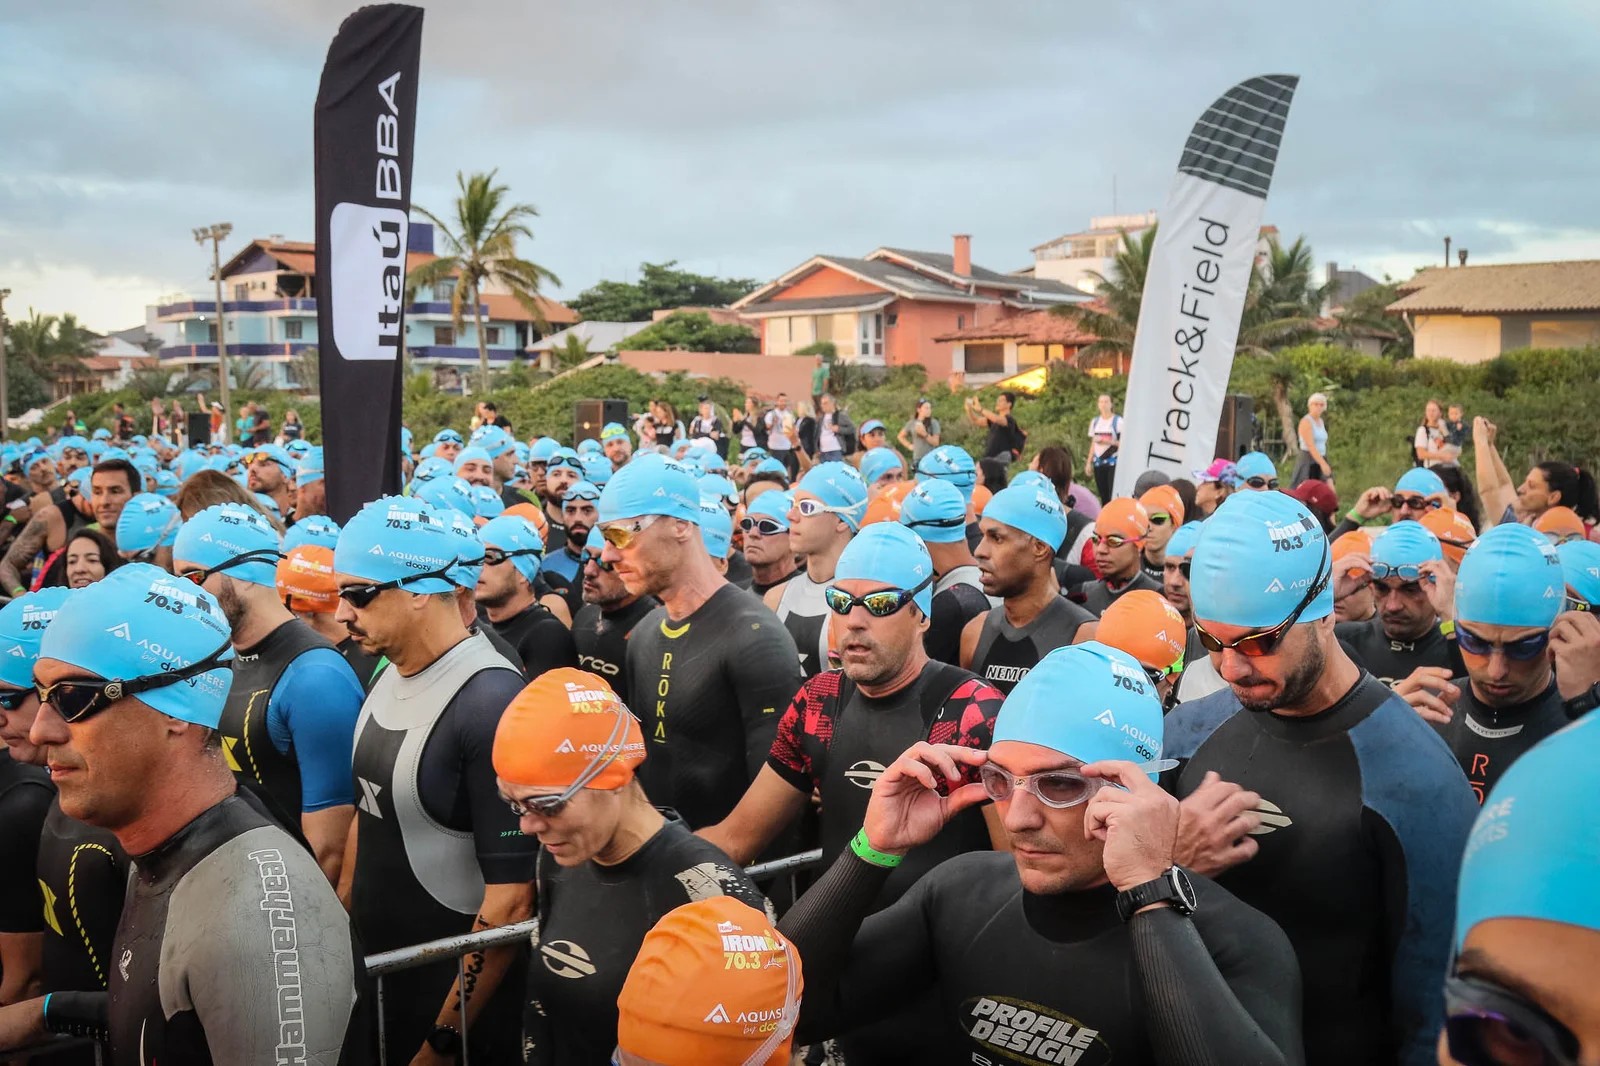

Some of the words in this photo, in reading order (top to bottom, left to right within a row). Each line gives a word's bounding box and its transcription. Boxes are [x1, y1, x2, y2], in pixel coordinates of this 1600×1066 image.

[375, 70, 402, 201] BBA
[372, 220, 401, 348] Itaú
[1146, 216, 1231, 468] Track&Field
[218, 515, 241, 526] 70.3
[385, 518, 412, 531] 70.3
[1271, 535, 1304, 553] 70.3
[405, 560, 432, 572] doozy
[143, 591, 185, 615] 70.3
[1112, 673, 1145, 695] 70.3
[570, 700, 603, 714] 70.3
[722, 950, 762, 970] 70.3
[971, 997, 1100, 1050] PROFILE
[969, 1018, 1085, 1066] DESIGN
